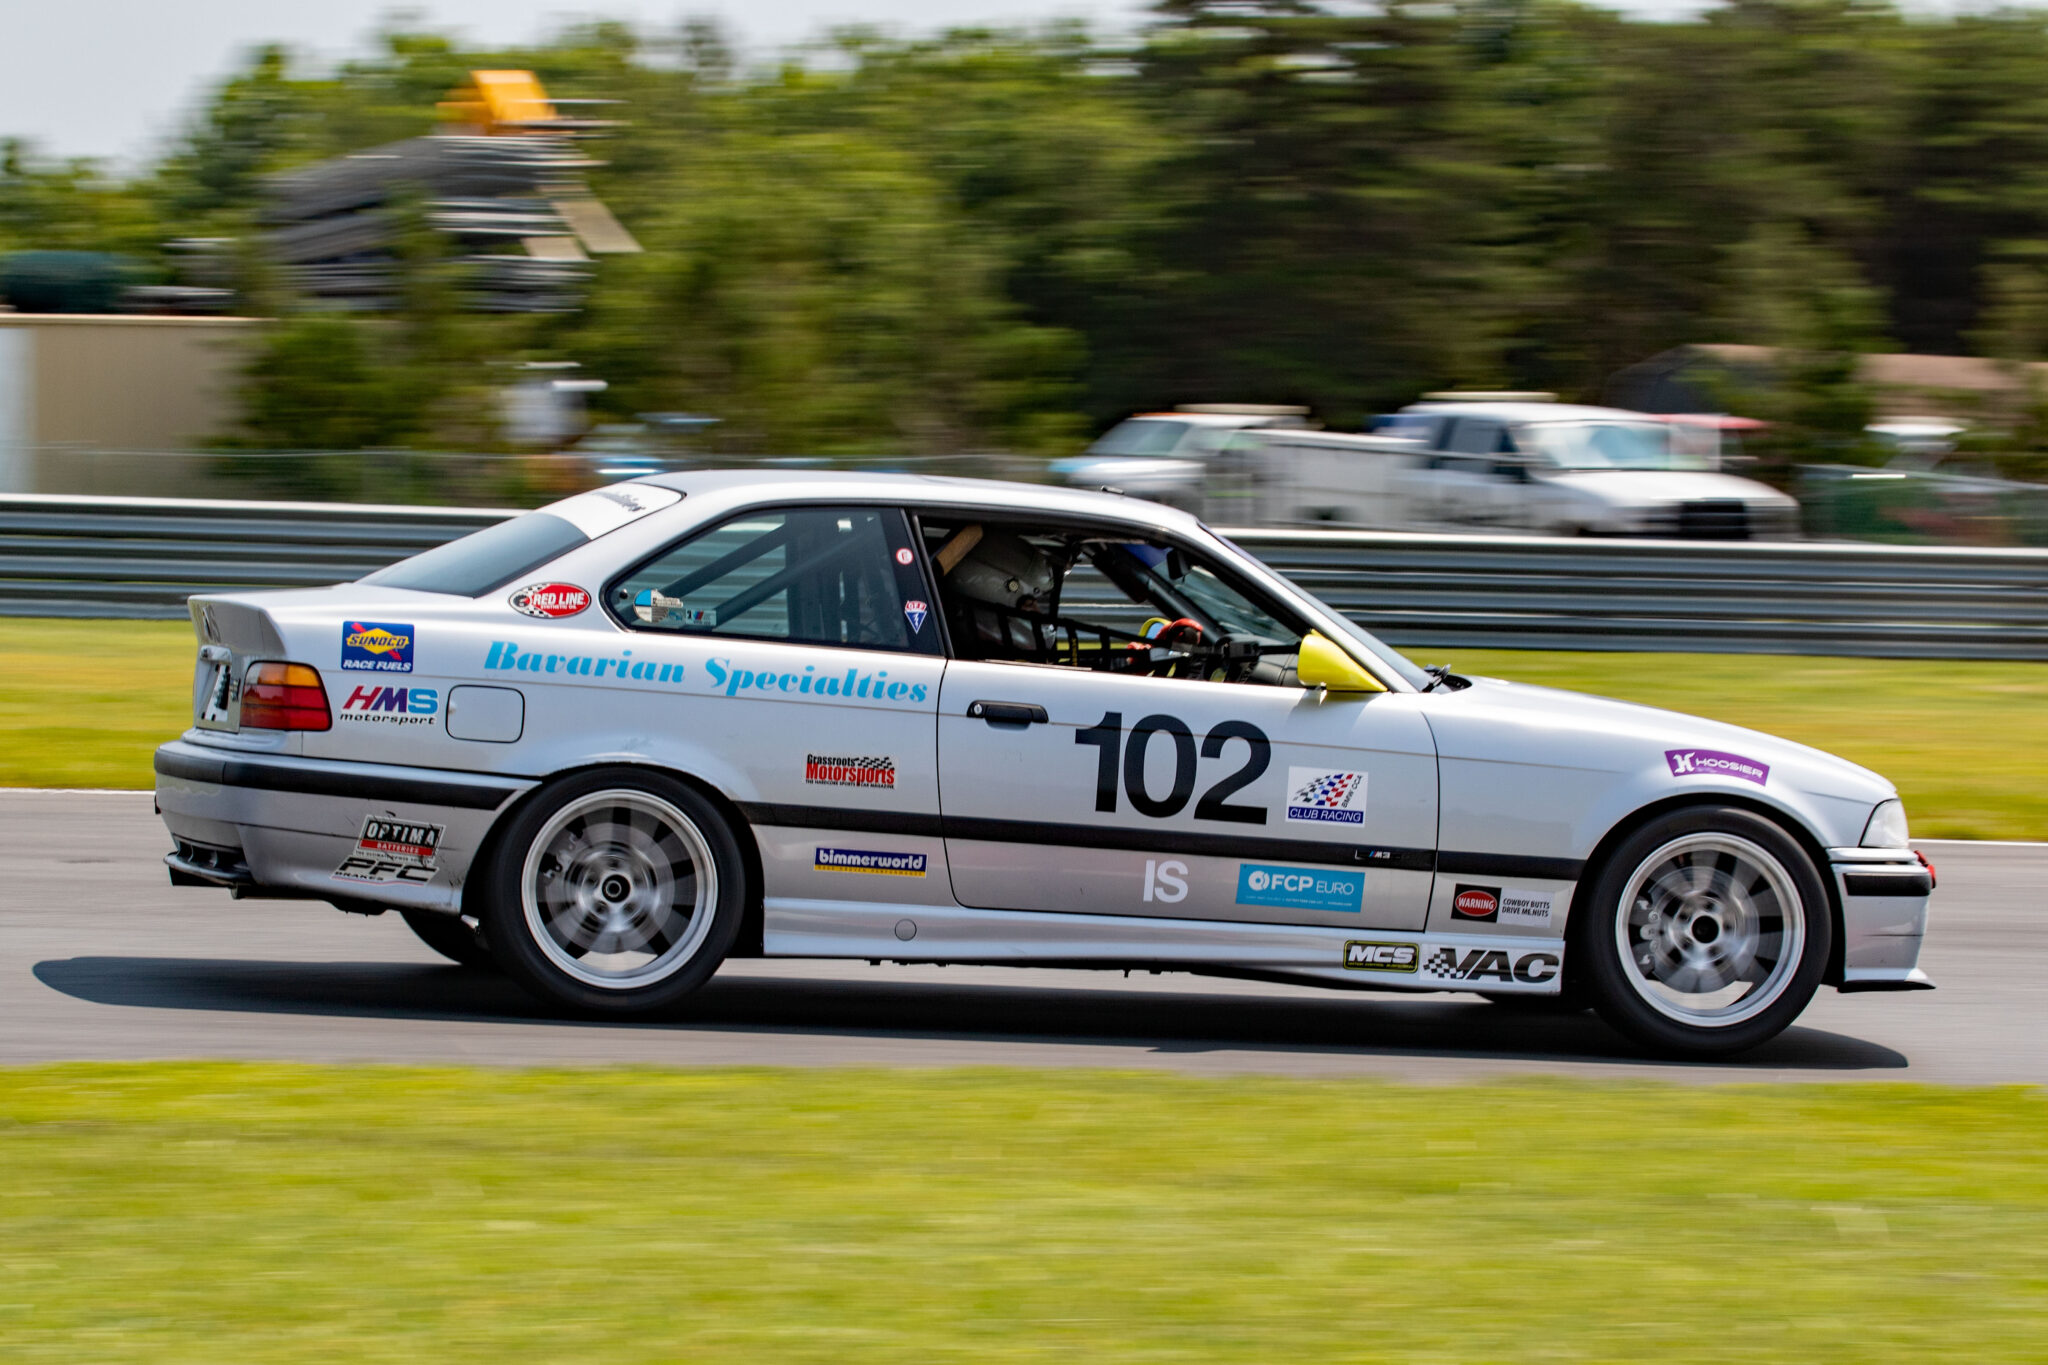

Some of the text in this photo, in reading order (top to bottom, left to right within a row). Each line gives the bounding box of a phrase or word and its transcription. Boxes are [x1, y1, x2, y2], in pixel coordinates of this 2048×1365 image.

[533, 592, 584, 605] RED LINE
[348, 634, 406, 647] SUNOCO
[343, 660, 412, 671] RACE FUELS
[483, 640, 928, 704] Bavarian Specialties
[342, 685, 438, 715] HMS
[340, 713, 436, 725] motorsport
[806, 753, 856, 767] Grassroots
[1074, 711, 1271, 826] 102
[1695, 757, 1764, 779] HOOSIER
[805, 763, 896, 787] Motorsports
[1289, 808, 1362, 823] CLUB RACING
[366, 821, 436, 846] OPTIMA
[338, 856, 437, 882] PFC
[819, 849, 923, 870] bimmerworld
[1142, 859, 1189, 904] IS
[1271, 873, 1355, 896] FCP EURO
[1458, 897, 1495, 911] WARNING
[1501, 906, 1521, 915] DRIVE
[1503, 898, 1550, 910] COWBOY BUTTS
[1349, 945, 1415, 964] MCS
[1440, 947, 1560, 984] VAC
